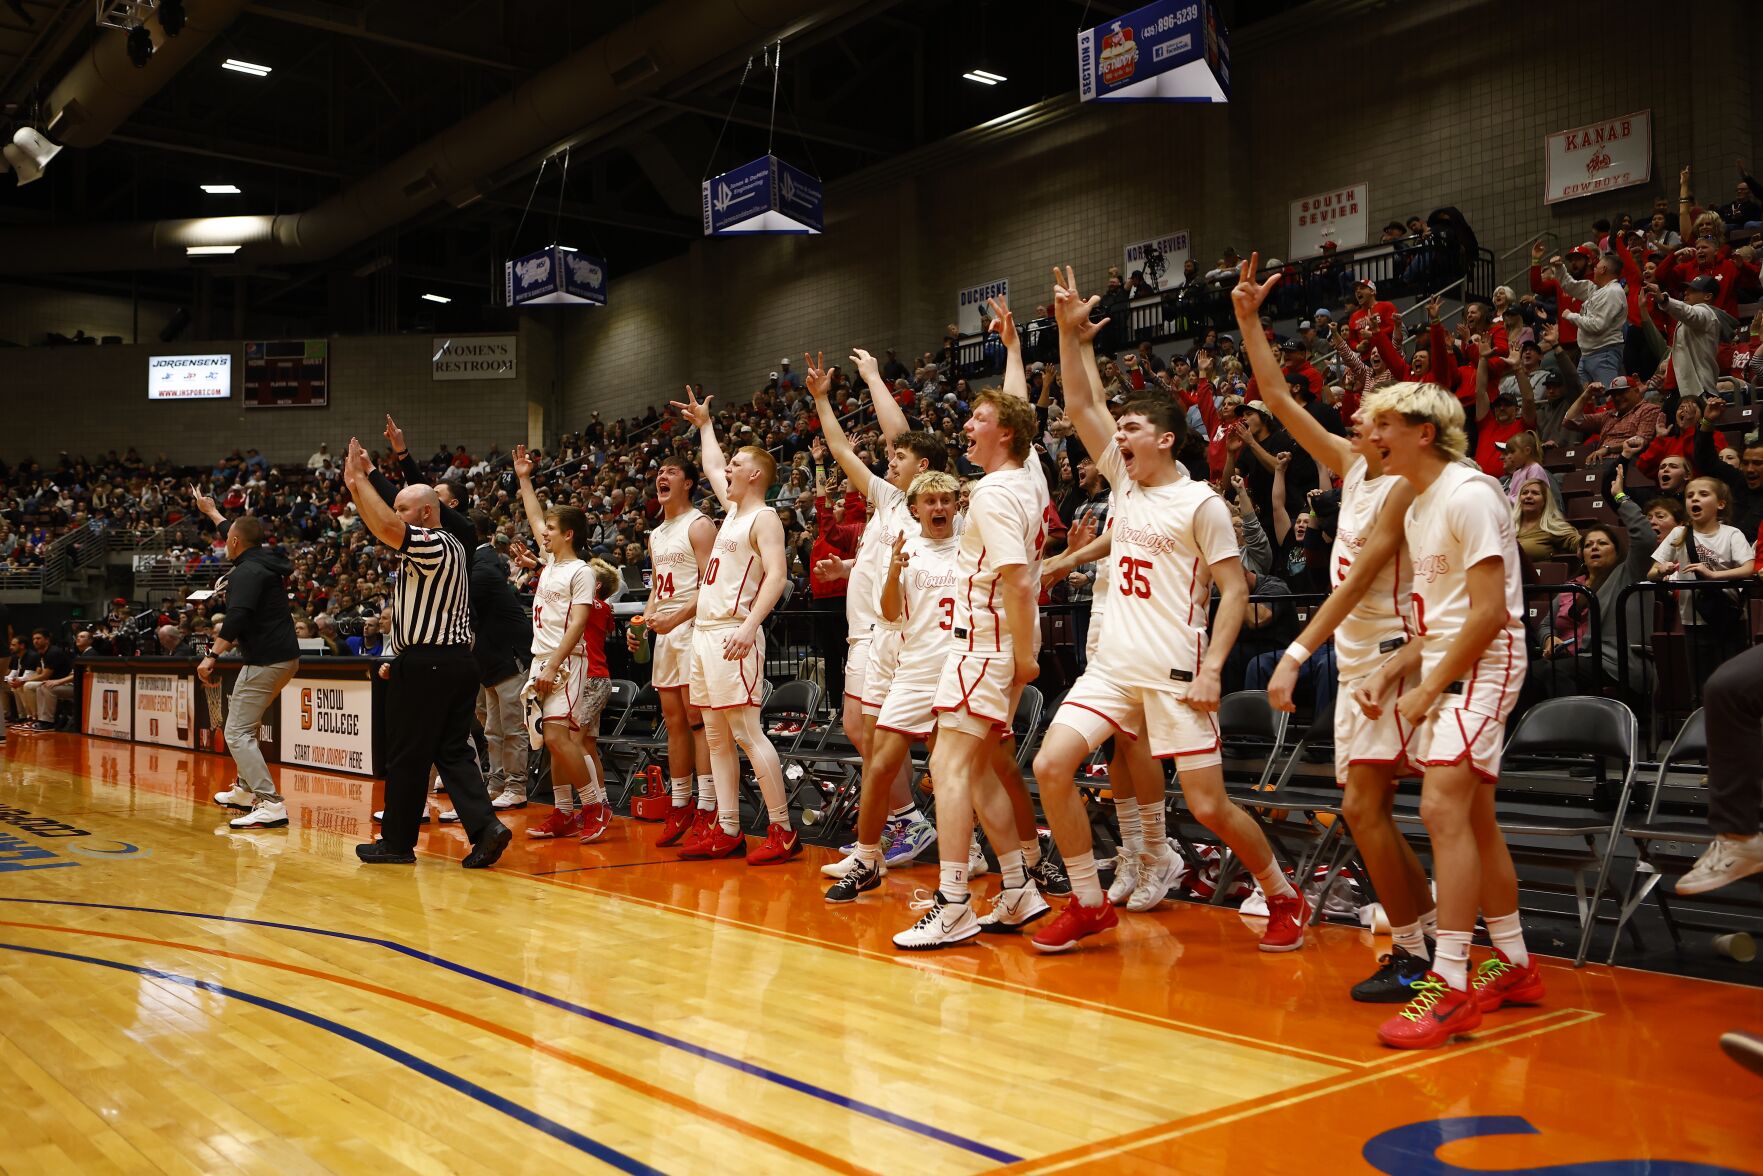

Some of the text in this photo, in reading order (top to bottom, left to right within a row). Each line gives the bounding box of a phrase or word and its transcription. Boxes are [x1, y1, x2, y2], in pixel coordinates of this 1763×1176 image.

[1158, 4, 1198, 33] 896-5239
[1082, 36, 1092, 95] SECTION 3
[1565, 121, 1632, 151] KANAB
[1563, 173, 1631, 195] COWBOYS
[1301, 190, 1355, 213] SOUTH
[1298, 203, 1359, 227] SEVIER
[1157, 235, 1187, 254] SEVIER
[961, 282, 1007, 306] DUCHESNE
[152, 357, 228, 368] JORGENSEN'S
[435, 360, 513, 372] RESTROOM
[1114, 517, 1176, 556] Cowboys
[657, 572, 675, 599] 24
[1119, 556, 1153, 599] 35
[938, 598, 955, 630] 3
[316, 688, 344, 711] SNOW
[317, 711, 359, 736] COLLEGE
[294, 744, 363, 770] START YOUR JOURNEY HERE
